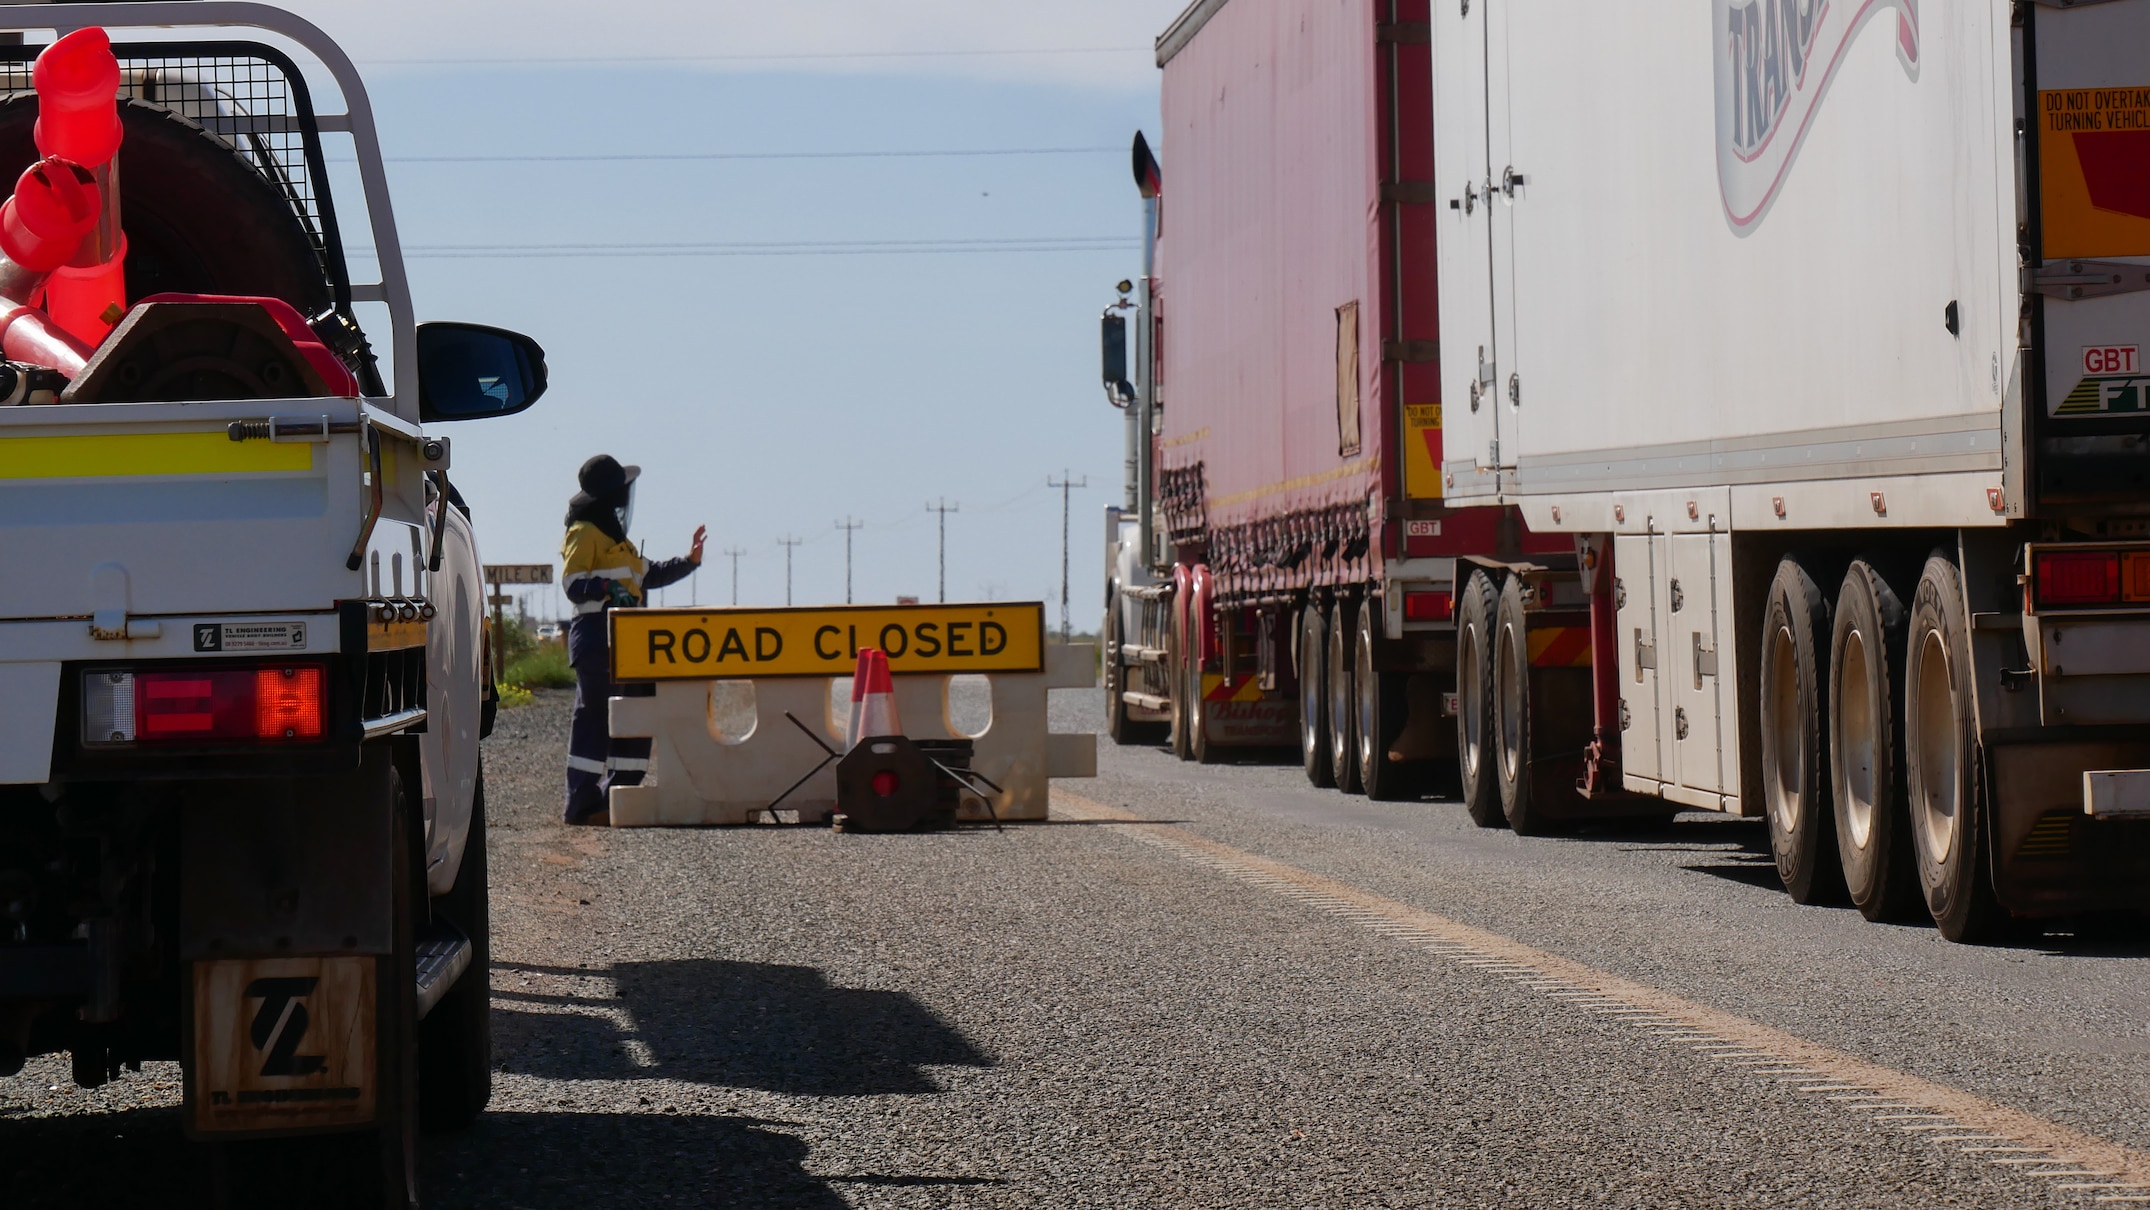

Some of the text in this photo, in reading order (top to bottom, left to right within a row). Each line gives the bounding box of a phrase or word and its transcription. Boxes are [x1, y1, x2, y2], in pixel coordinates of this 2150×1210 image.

[2046, 89, 2150, 111] DO NOT OVERTAK
[2048, 110, 2150, 131] TURNING VEHICL
[2084, 347, 2136, 373] GBT
[1408, 407, 1418, 417] DO
[1420, 406, 1434, 417] NOT
[1410, 417, 1440, 428] TURNING
[1409, 521, 1437, 535] GBT
[487, 567, 522, 582] MILE
[236, 626, 287, 634] ENGINEERING
[647, 621, 1008, 665] ROAD CLOSED
